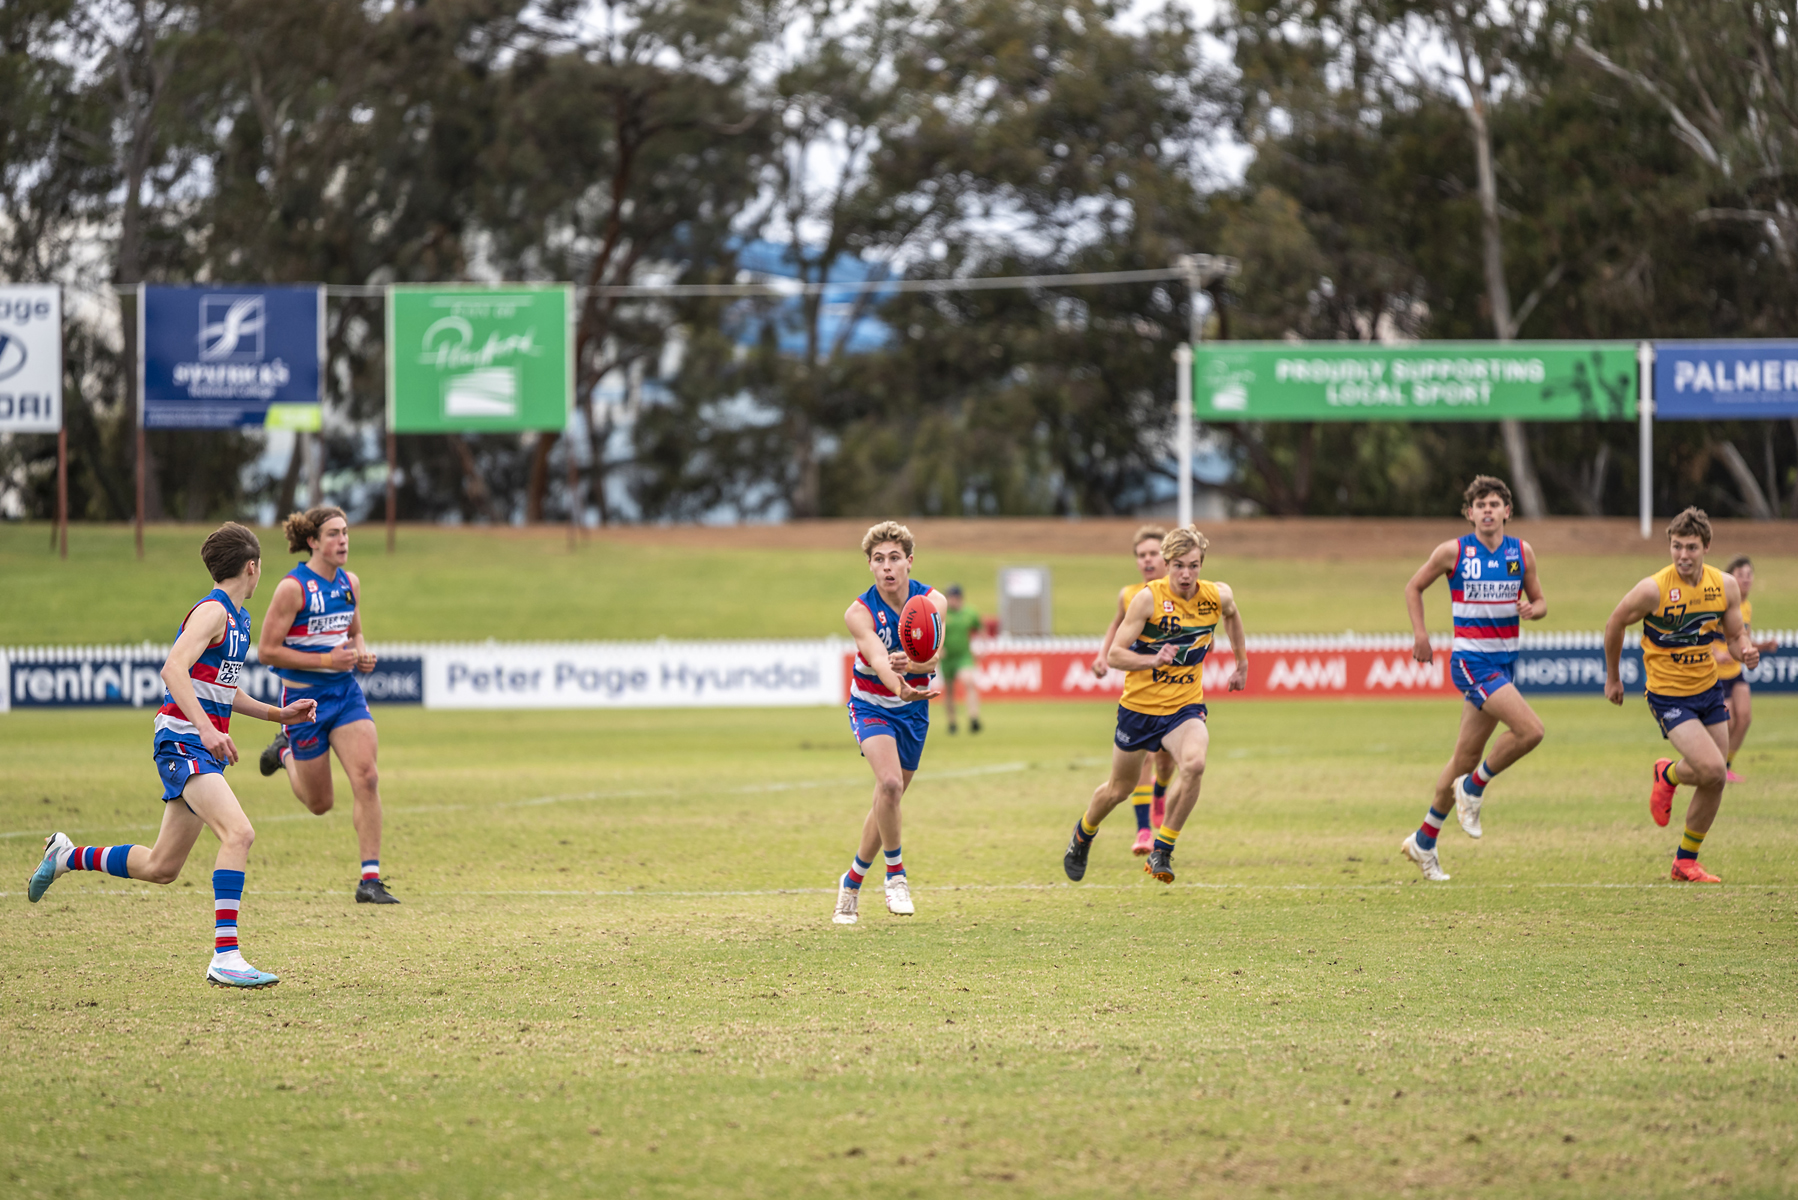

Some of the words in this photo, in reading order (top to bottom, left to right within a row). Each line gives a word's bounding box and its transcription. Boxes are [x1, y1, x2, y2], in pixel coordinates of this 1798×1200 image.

[1275, 358, 1386, 384] PROUDLY
[1391, 358, 1546, 384] SUPPORTING
[1326, 380, 1408, 407] LOCAL
[1411, 379, 1494, 407] SPORT
[1461, 557, 1482, 580] 30
[1465, 583, 1495, 591] PETER
[310, 590, 326, 614] 41
[1662, 603, 1687, 627] 57
[904, 608, 920, 657] SHERRIN
[1158, 615, 1183, 635] 46
[228, 629, 240, 658] 17
[447, 661, 542, 693] Peter
[555, 661, 648, 697] Page
[660, 661, 821, 697] Hyundai
[1515, 656, 1640, 685] HOSTPLS
